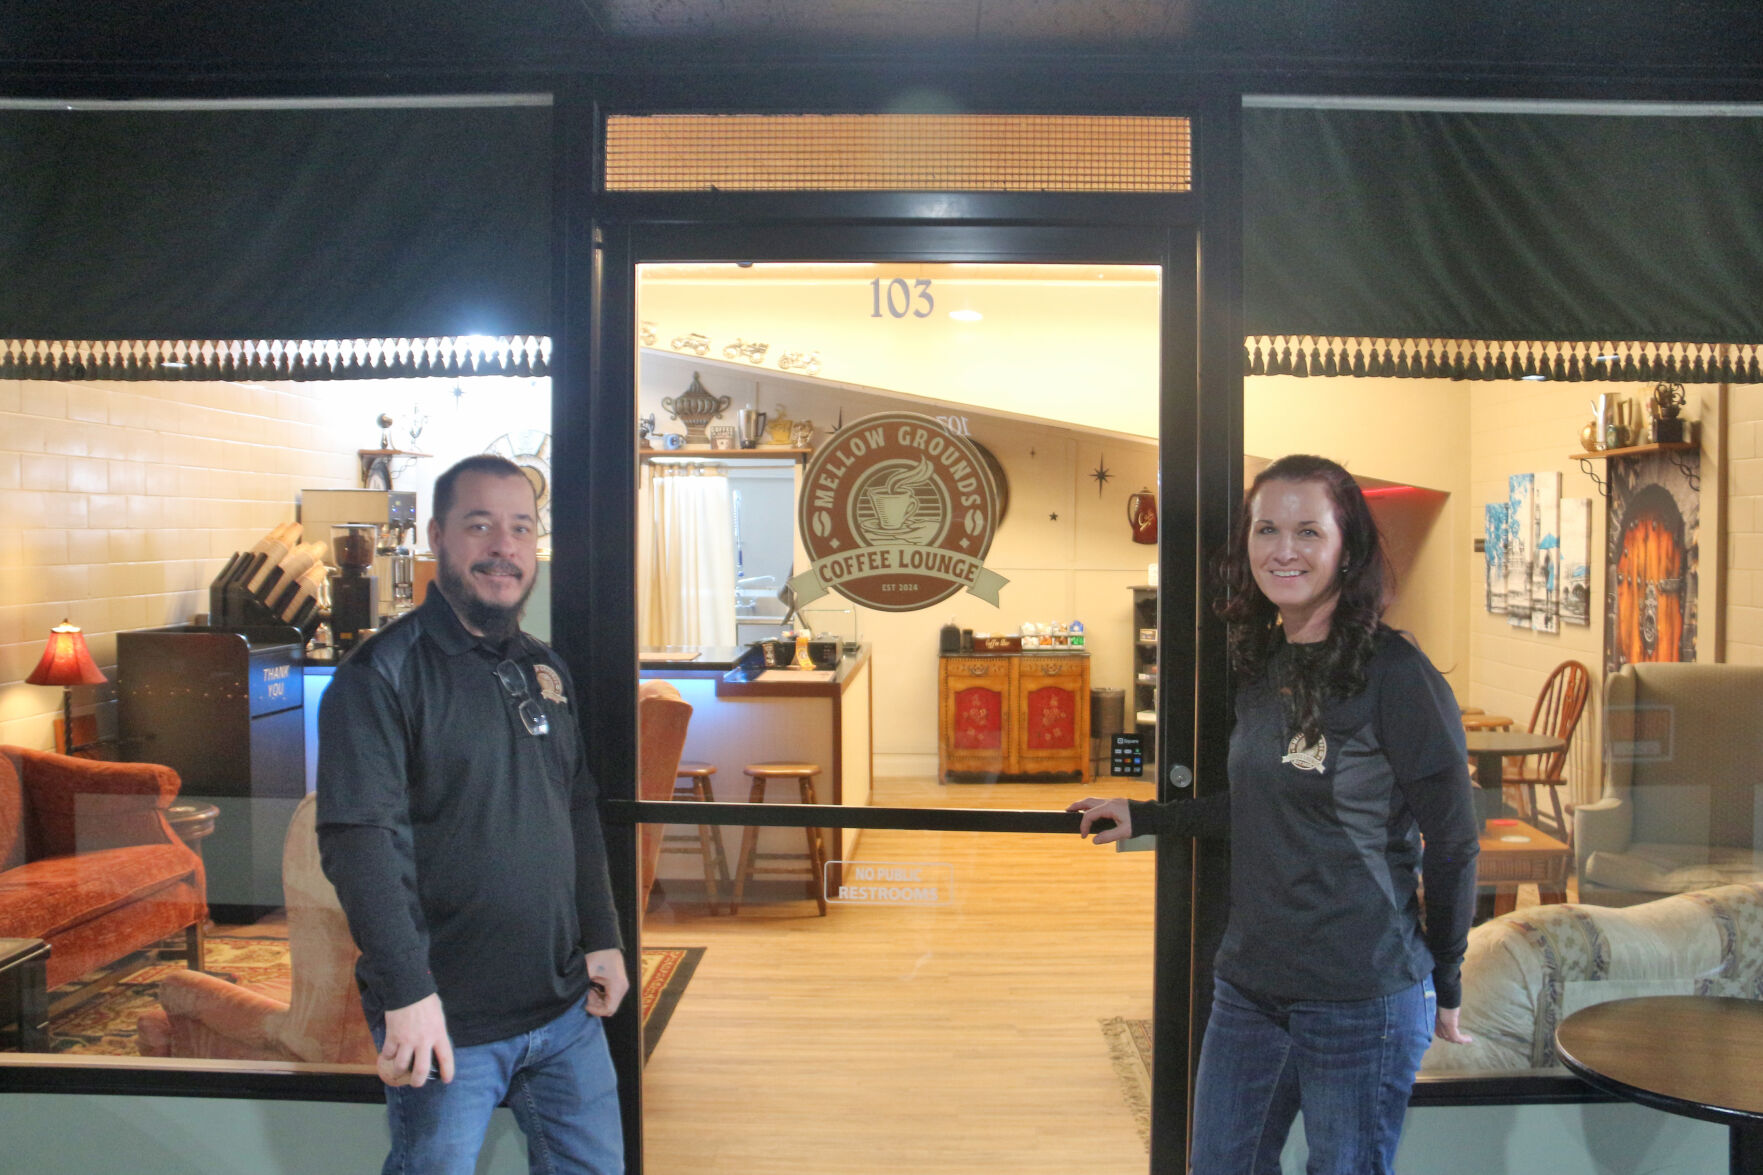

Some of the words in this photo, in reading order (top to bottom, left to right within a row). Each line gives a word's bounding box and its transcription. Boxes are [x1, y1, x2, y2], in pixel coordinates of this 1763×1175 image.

[871, 277, 934, 318] 103
[814, 427, 886, 509] MELLOW
[897, 426, 981, 507] GROUNDS
[818, 550, 891, 583] COFFEE
[898, 549, 979, 583] LOUNGE
[882, 583, 896, 592] EST
[264, 665, 290, 681] THANK
[268, 682, 284, 697] YOU
[855, 867, 875, 881] NO
[877, 868, 922, 882] PUBLIC
[838, 886, 939, 901] RESTROOMS
